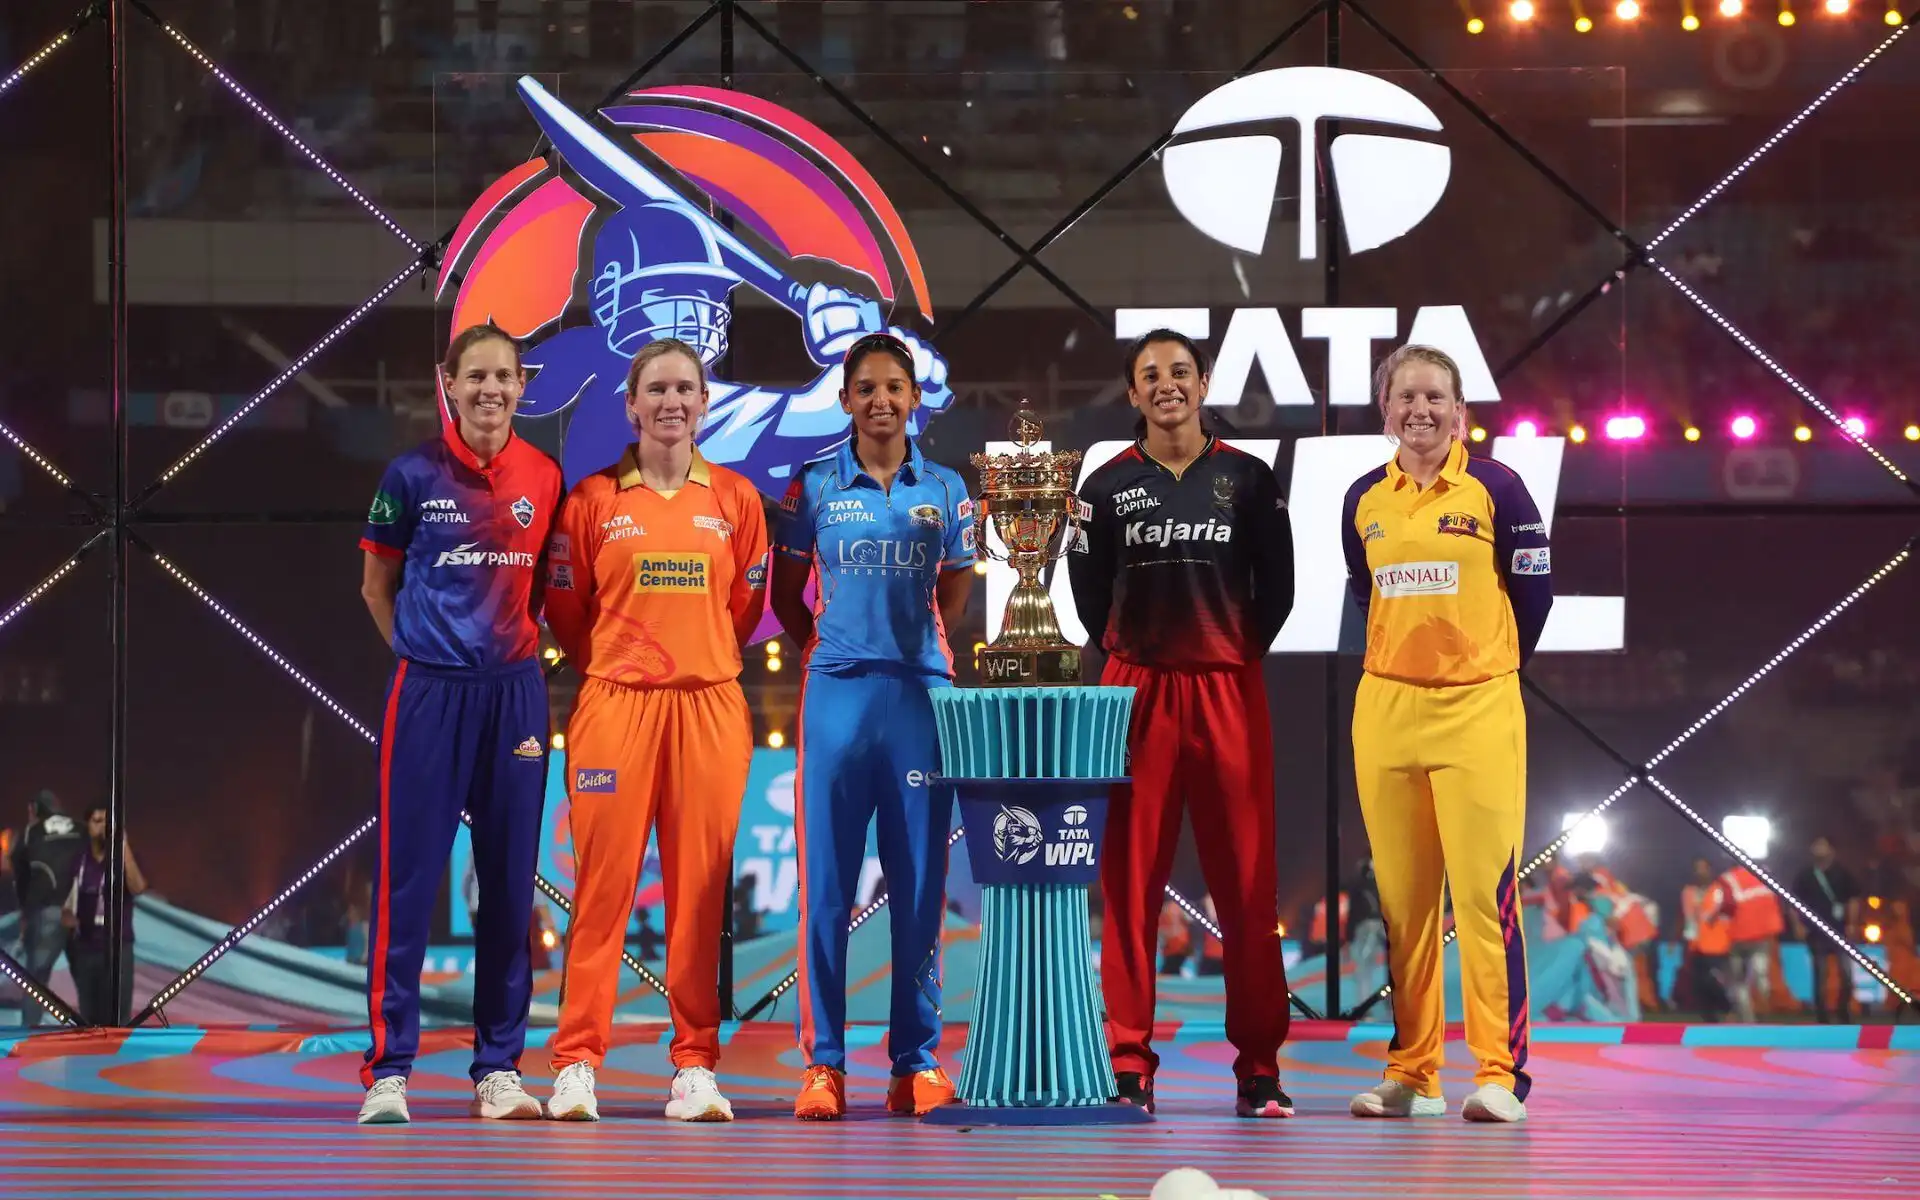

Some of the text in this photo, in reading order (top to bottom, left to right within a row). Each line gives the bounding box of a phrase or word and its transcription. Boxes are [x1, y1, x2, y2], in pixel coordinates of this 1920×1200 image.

[1115, 305, 1501, 406] TATA
[1113, 487, 1147, 504] TATA
[421, 499, 457, 510] TATA
[828, 500, 864, 512] TATA
[1116, 497, 1161, 517] CAPITAL
[422, 512, 470, 523] CAPITAL
[601, 515, 633, 530] TATA
[827, 512, 877, 524] CAPITAL
[1125, 518, 1232, 548] Kajaria
[432, 551, 533, 567] JSW PAINTS
[839, 539, 927, 568] LOTUS
[641, 559, 704, 575] Ambuja
[840, 567, 925, 578] HERBALS
[640, 573, 705, 588] Cement
[986, 658, 1031, 677] WPL
[1058, 828, 1090, 840] TATA
[1045, 842, 1096, 866] WPL
